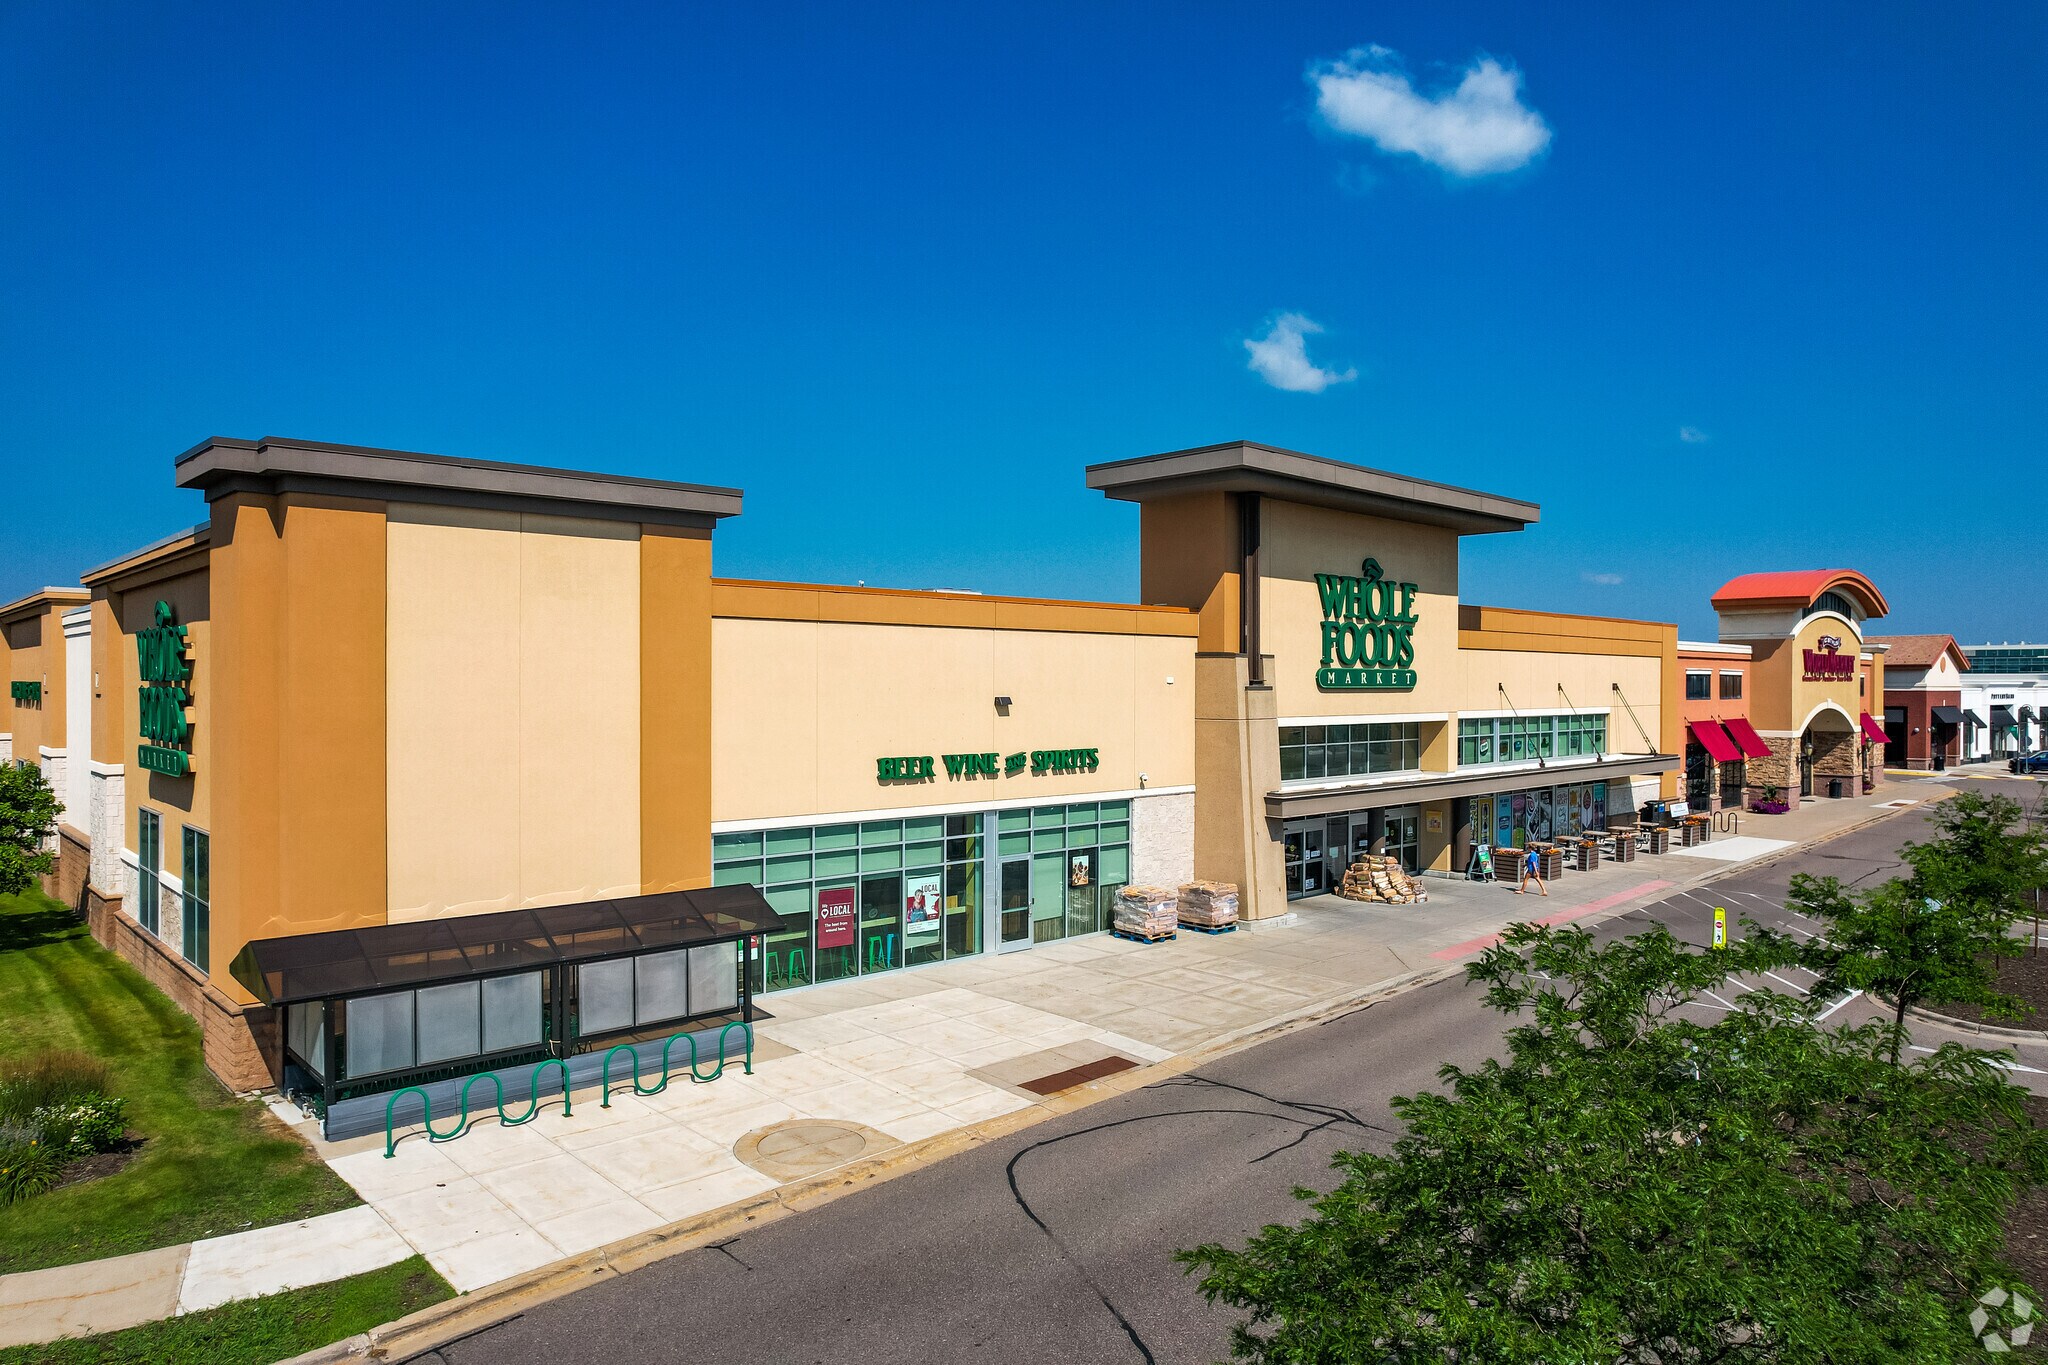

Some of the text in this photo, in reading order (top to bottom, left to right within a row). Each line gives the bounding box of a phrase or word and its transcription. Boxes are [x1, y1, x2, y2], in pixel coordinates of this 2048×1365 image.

[1314, 574, 1419, 623] WHOLE
[1320, 621, 1415, 667] FOODS
[1327, 671, 1412, 685] MARKET
[877, 748, 1099, 780] BEER WINE AND SPIRITS
[830, 904, 850, 916] LOCAL
